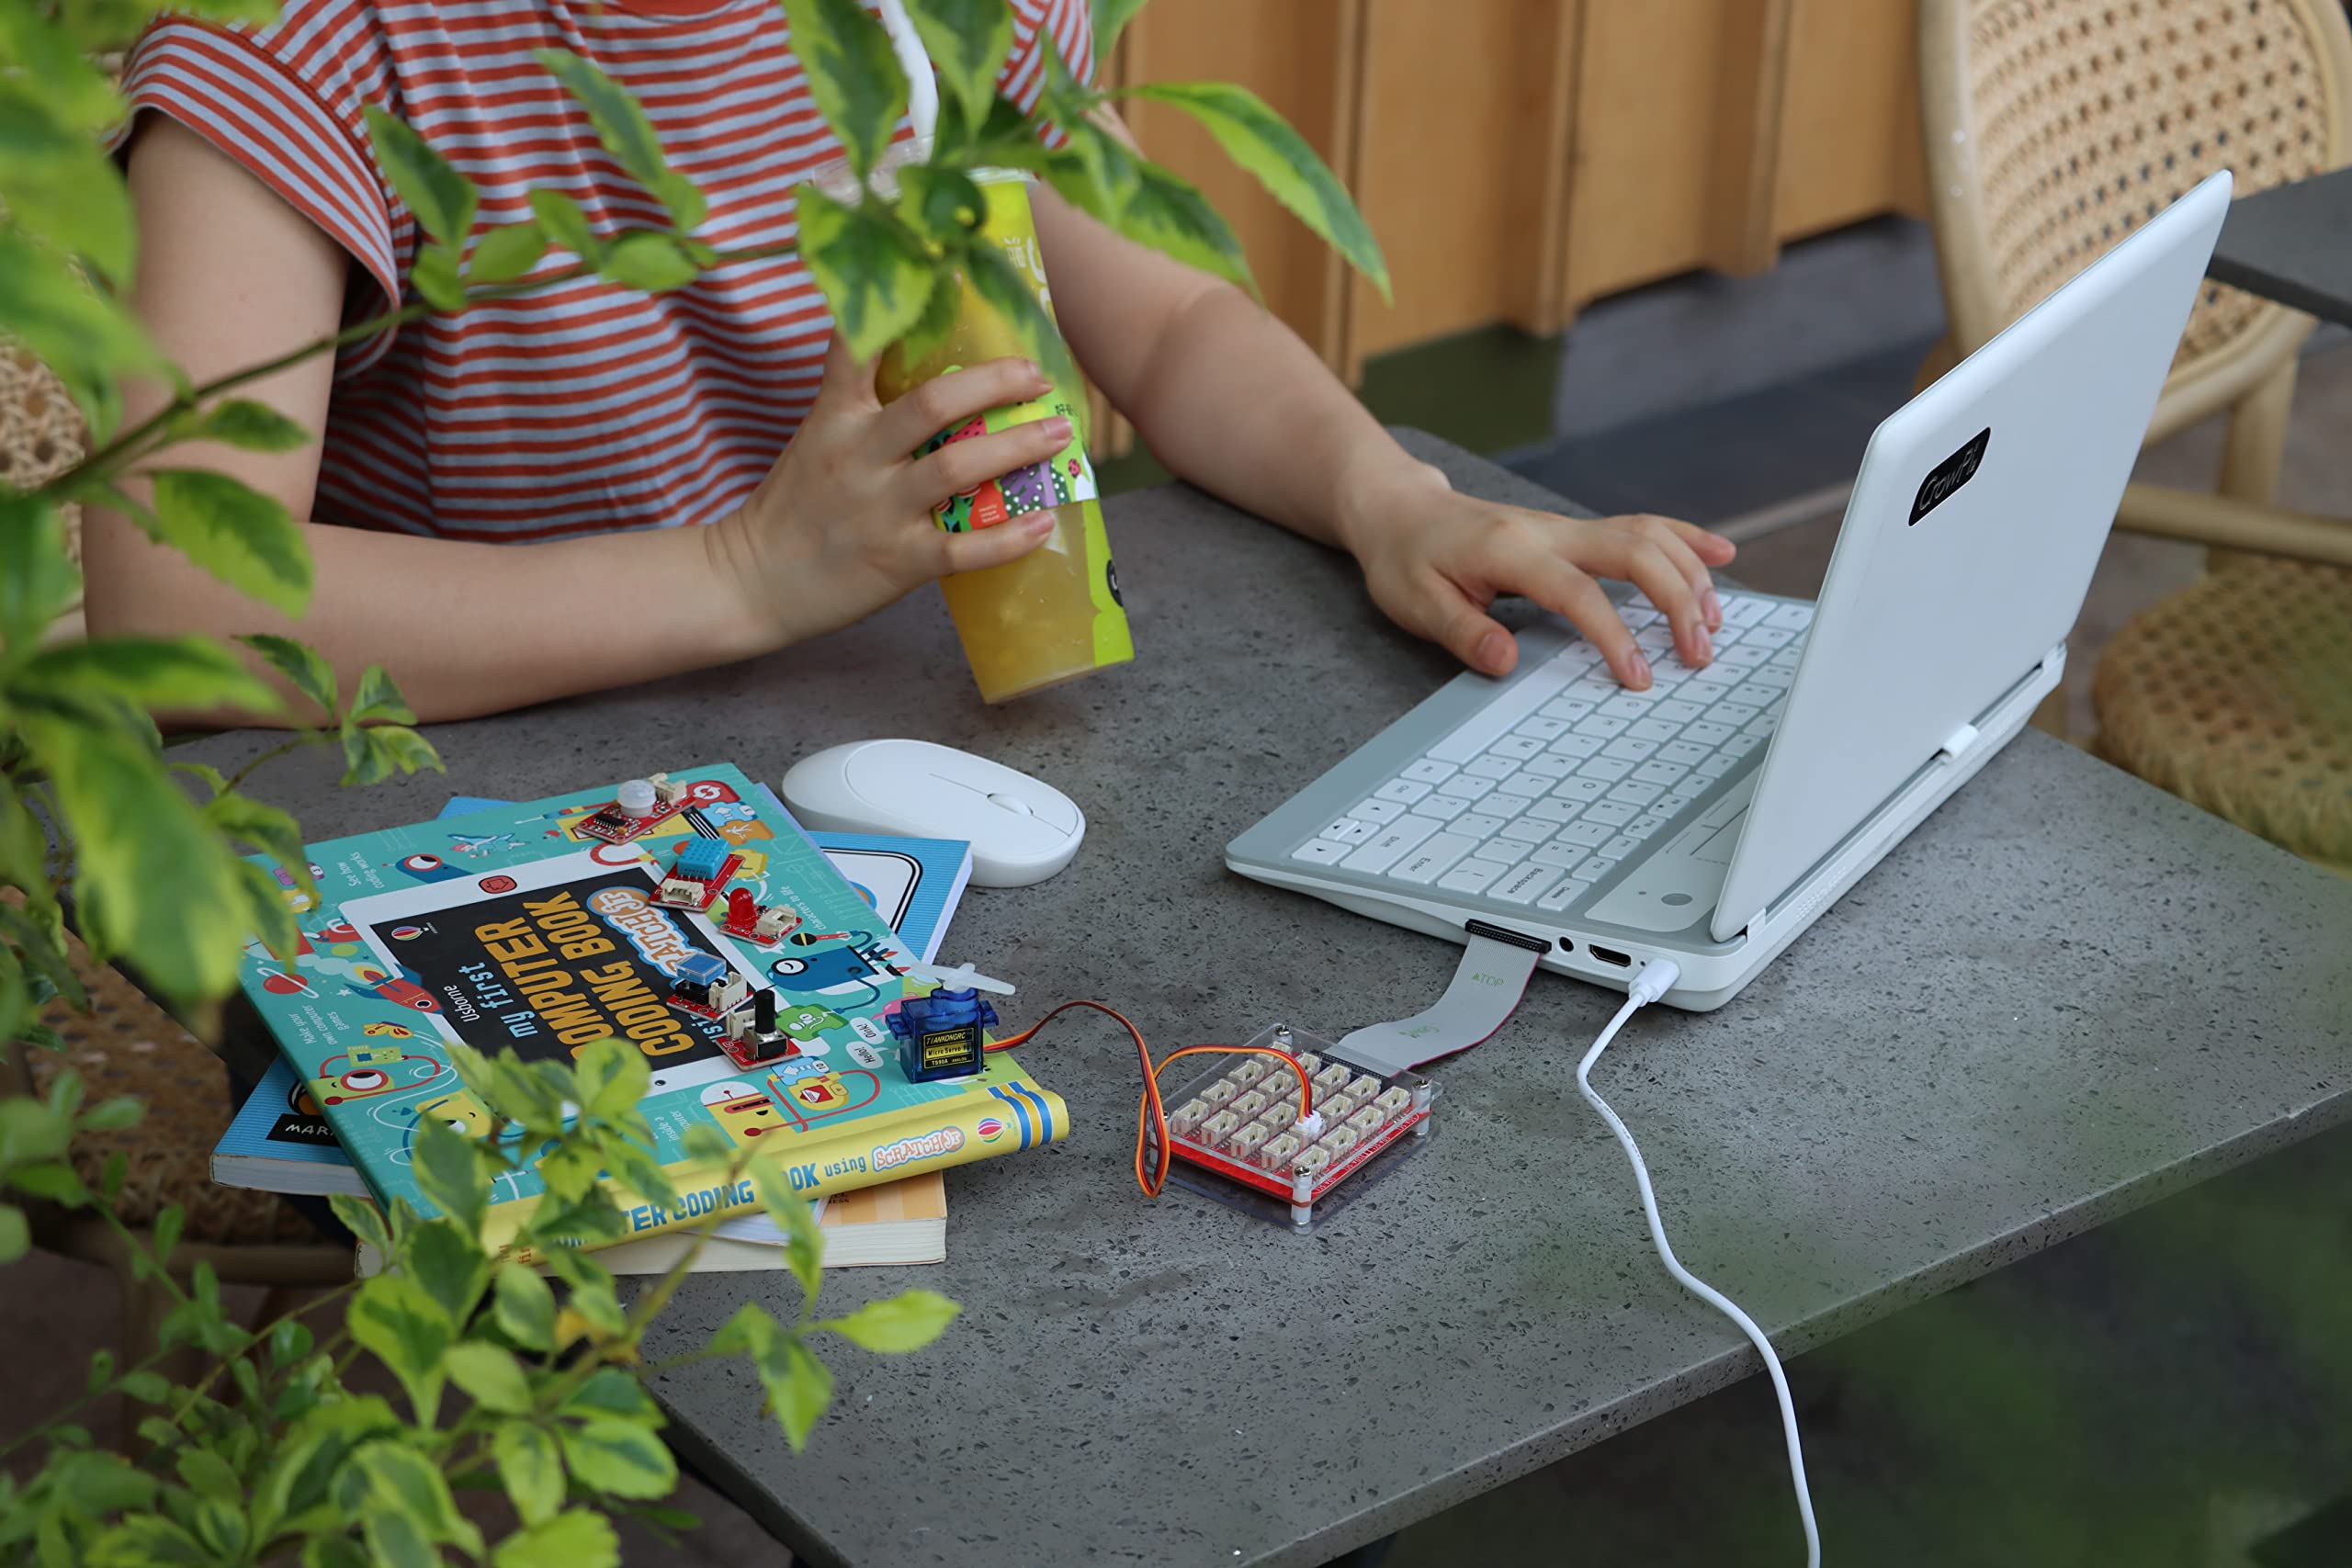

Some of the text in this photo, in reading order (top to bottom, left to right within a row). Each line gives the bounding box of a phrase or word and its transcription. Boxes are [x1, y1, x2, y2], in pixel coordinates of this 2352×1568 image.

[1409, 856, 1432, 874] Enter
[1506, 866, 1544, 895] Backspace
[522, 891, 695, 1056] CODING BOOK
[444, 985, 481, 1022] Usborne
[458, 962, 538, 1038] my first
[926, 1032, 967, 1045] TIANKONGRC
[928, 1048, 944, 1057] Micro
[944, 1045, 962, 1055] Servo
[285, 1123, 335, 1137] MAR
[824, 1156, 867, 1177] using
